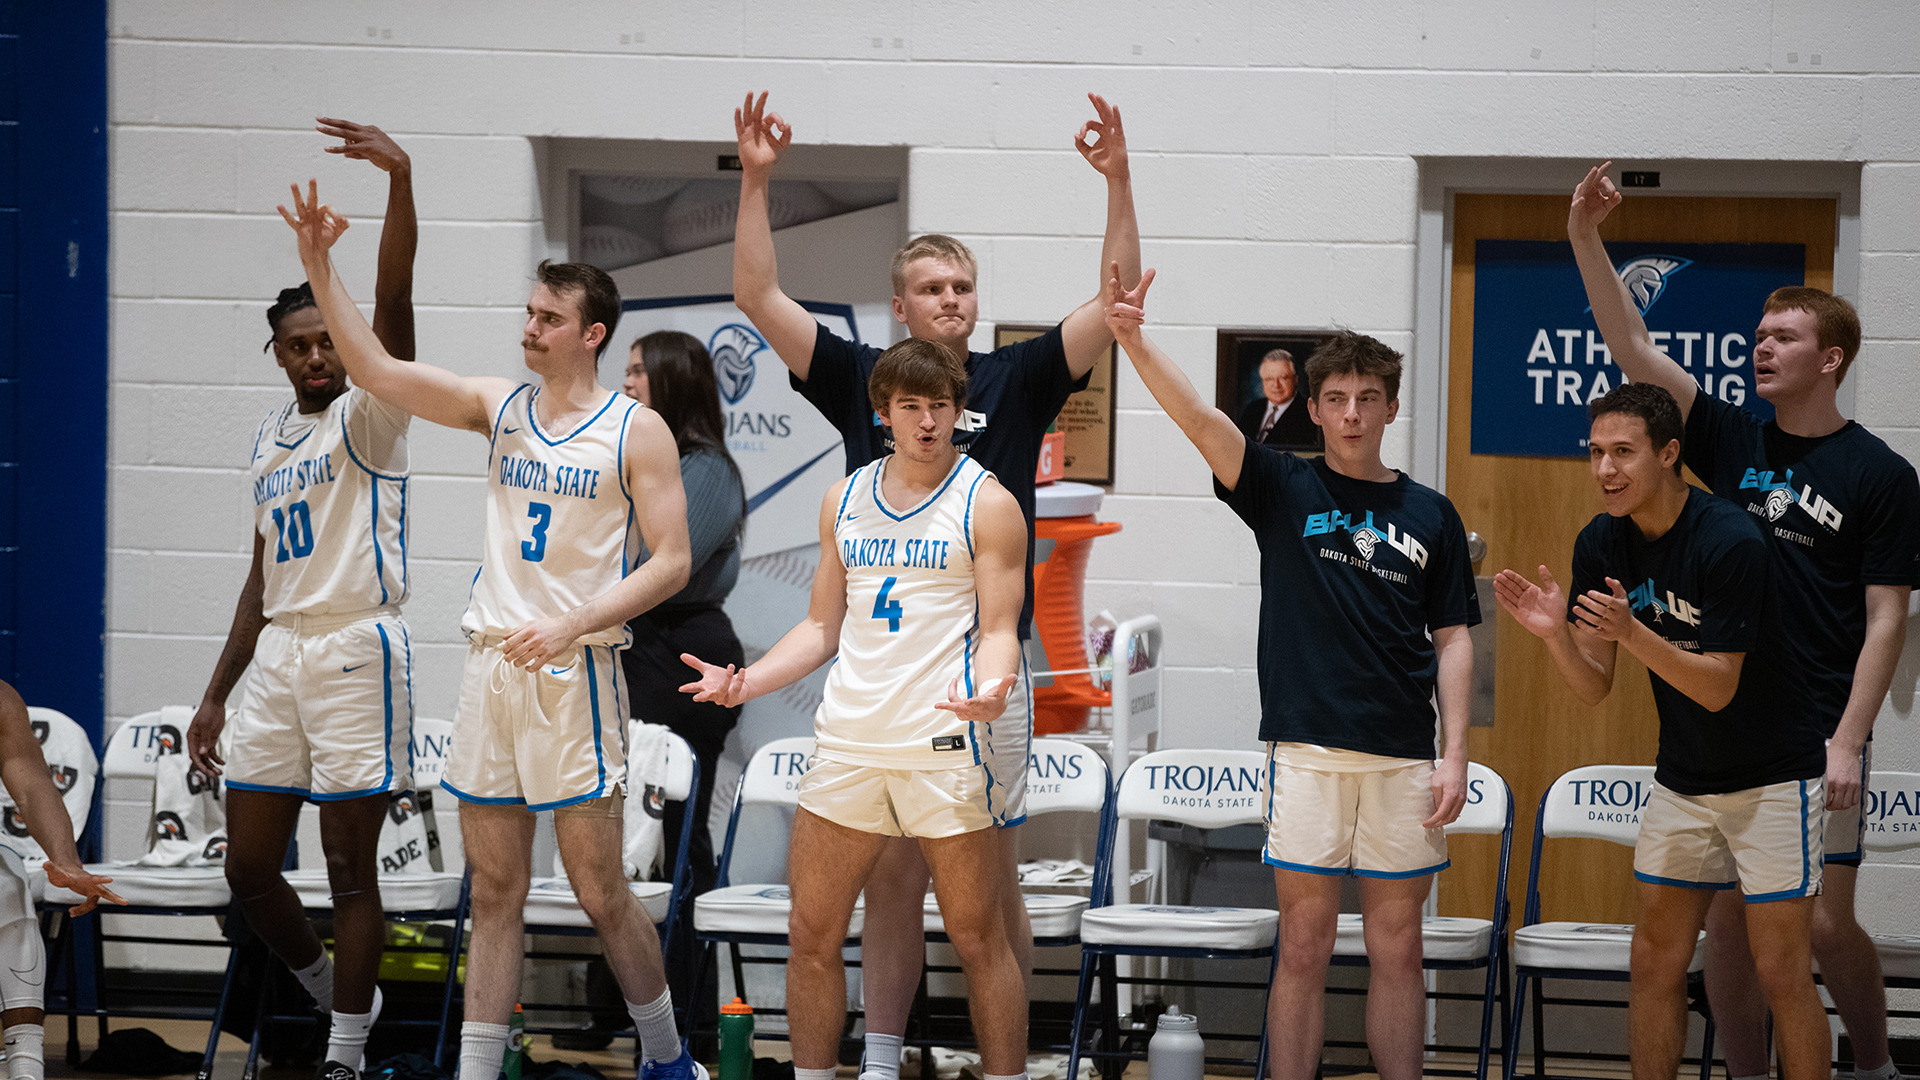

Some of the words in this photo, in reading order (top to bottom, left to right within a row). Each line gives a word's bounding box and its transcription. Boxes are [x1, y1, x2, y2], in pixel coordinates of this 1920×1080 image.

[1527, 329, 1747, 368] ATHETIC
[725, 411, 791, 438] JANS
[298, 453, 335, 491] STATE
[1041, 443, 1052, 475] G
[500, 455, 547, 492] DAKOTA
[554, 465, 600, 499] STATE
[1798, 484, 1843, 532] UP
[272, 500, 314, 563] 10
[521, 501, 552, 563] 3
[1387, 522, 1429, 570] UP
[1774, 527, 1815, 547] BASKETBALL
[844, 538, 896, 568] DAKOTA
[903, 538, 949, 570] STATE
[1320, 547, 1348, 563] DAKOTA
[1350, 556, 1370, 571] STATE
[871, 576, 903, 632] 4
[418, 763, 438, 773] ATE
[1144, 765, 1265, 796] TROJAN
[1163, 795, 1211, 808] DAKOTA
[1217, 797, 1254, 808] STATE
[1568, 780, 1651, 812] TROJ
[1588, 811, 1639, 824] DAKOTA
[1892, 822, 1920, 833] STA
